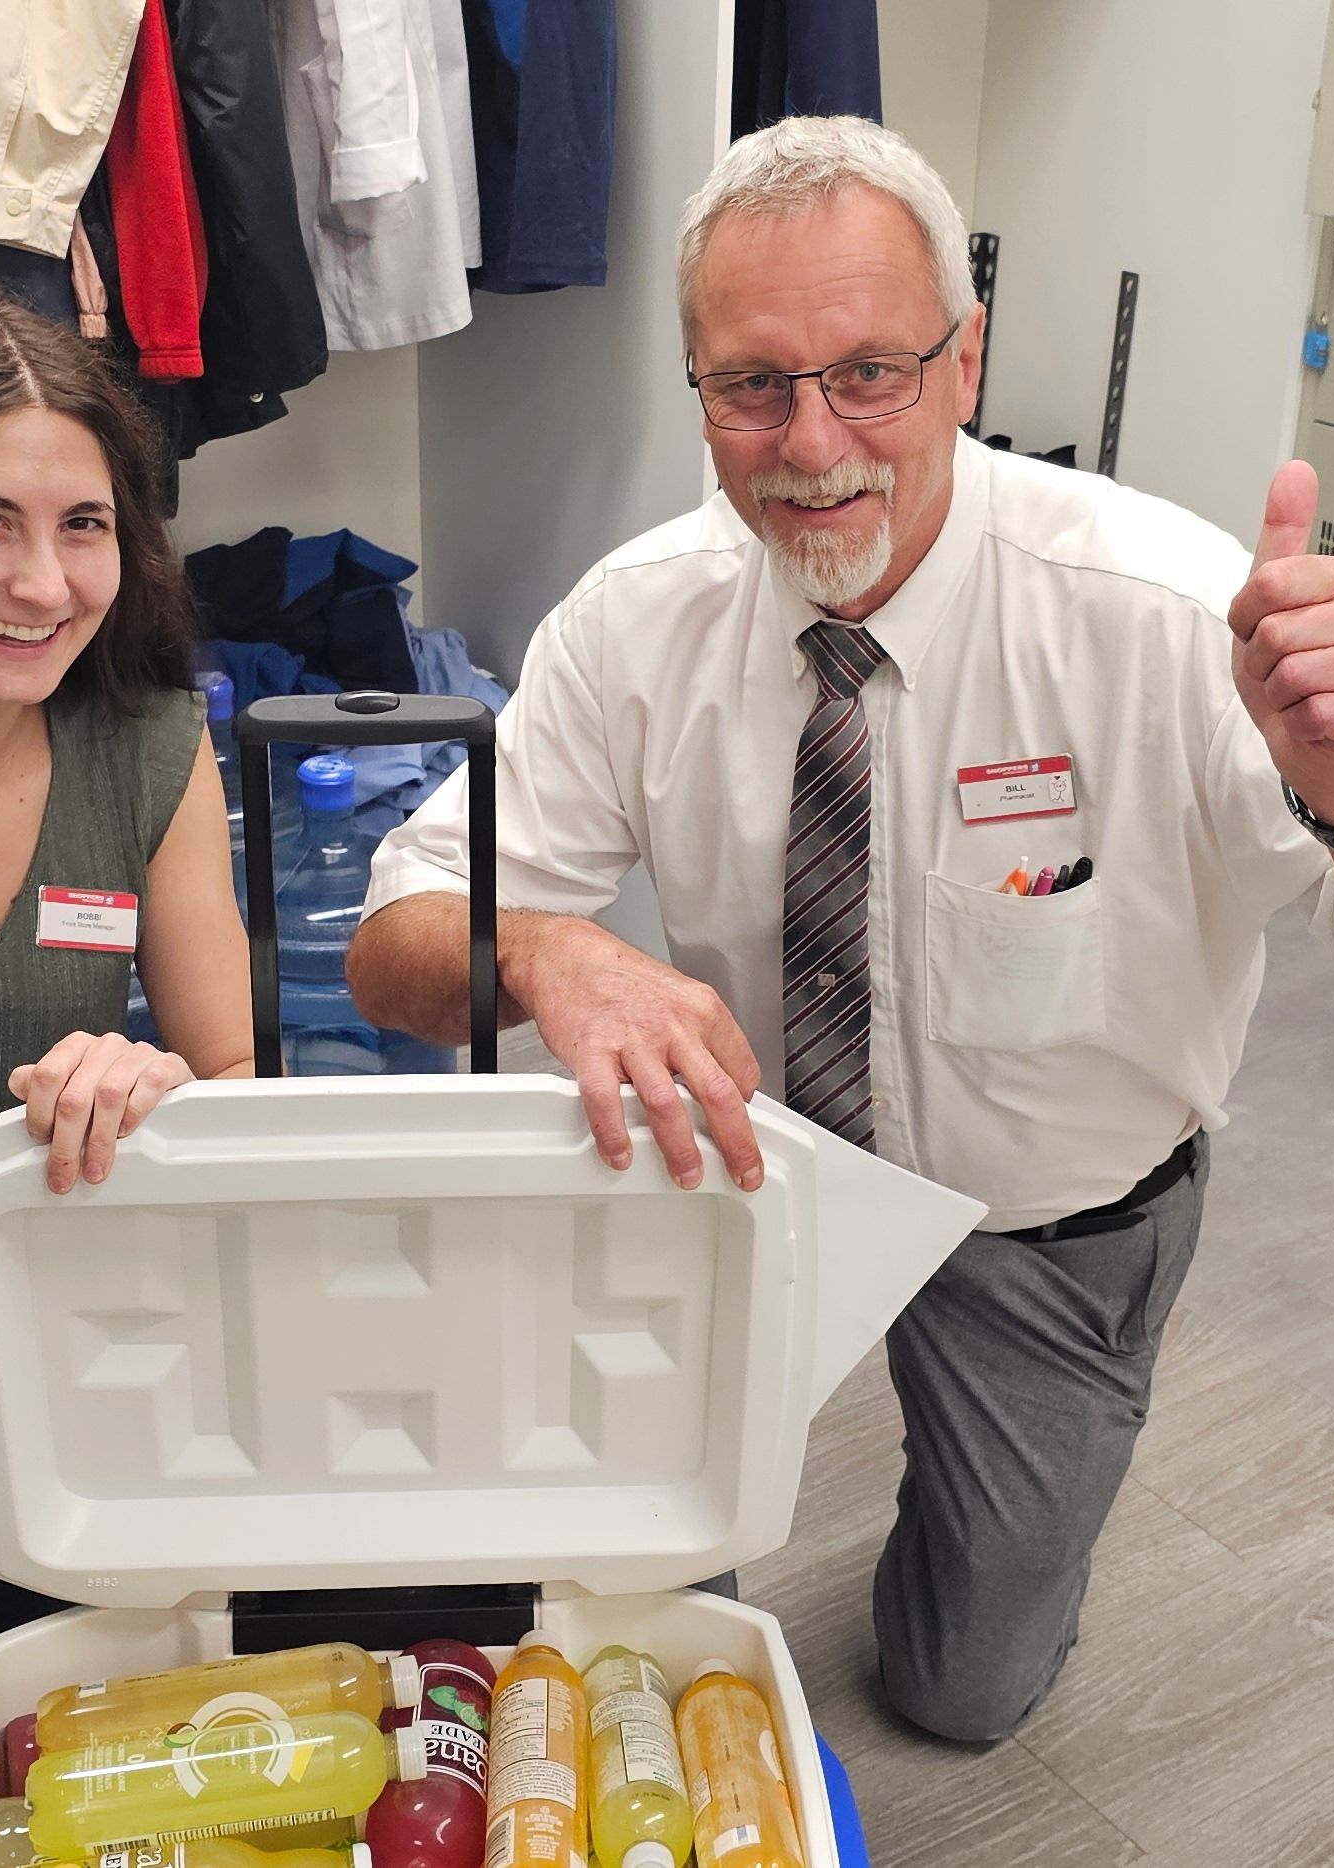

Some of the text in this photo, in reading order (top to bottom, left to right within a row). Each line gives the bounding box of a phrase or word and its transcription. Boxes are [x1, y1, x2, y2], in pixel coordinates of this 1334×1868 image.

[1005, 784, 1026, 792] BILL
[77, 912, 102, 920] BOBBI
[431, 1724, 488, 1754] EADE
[426, 1739, 487, 1792] bana
